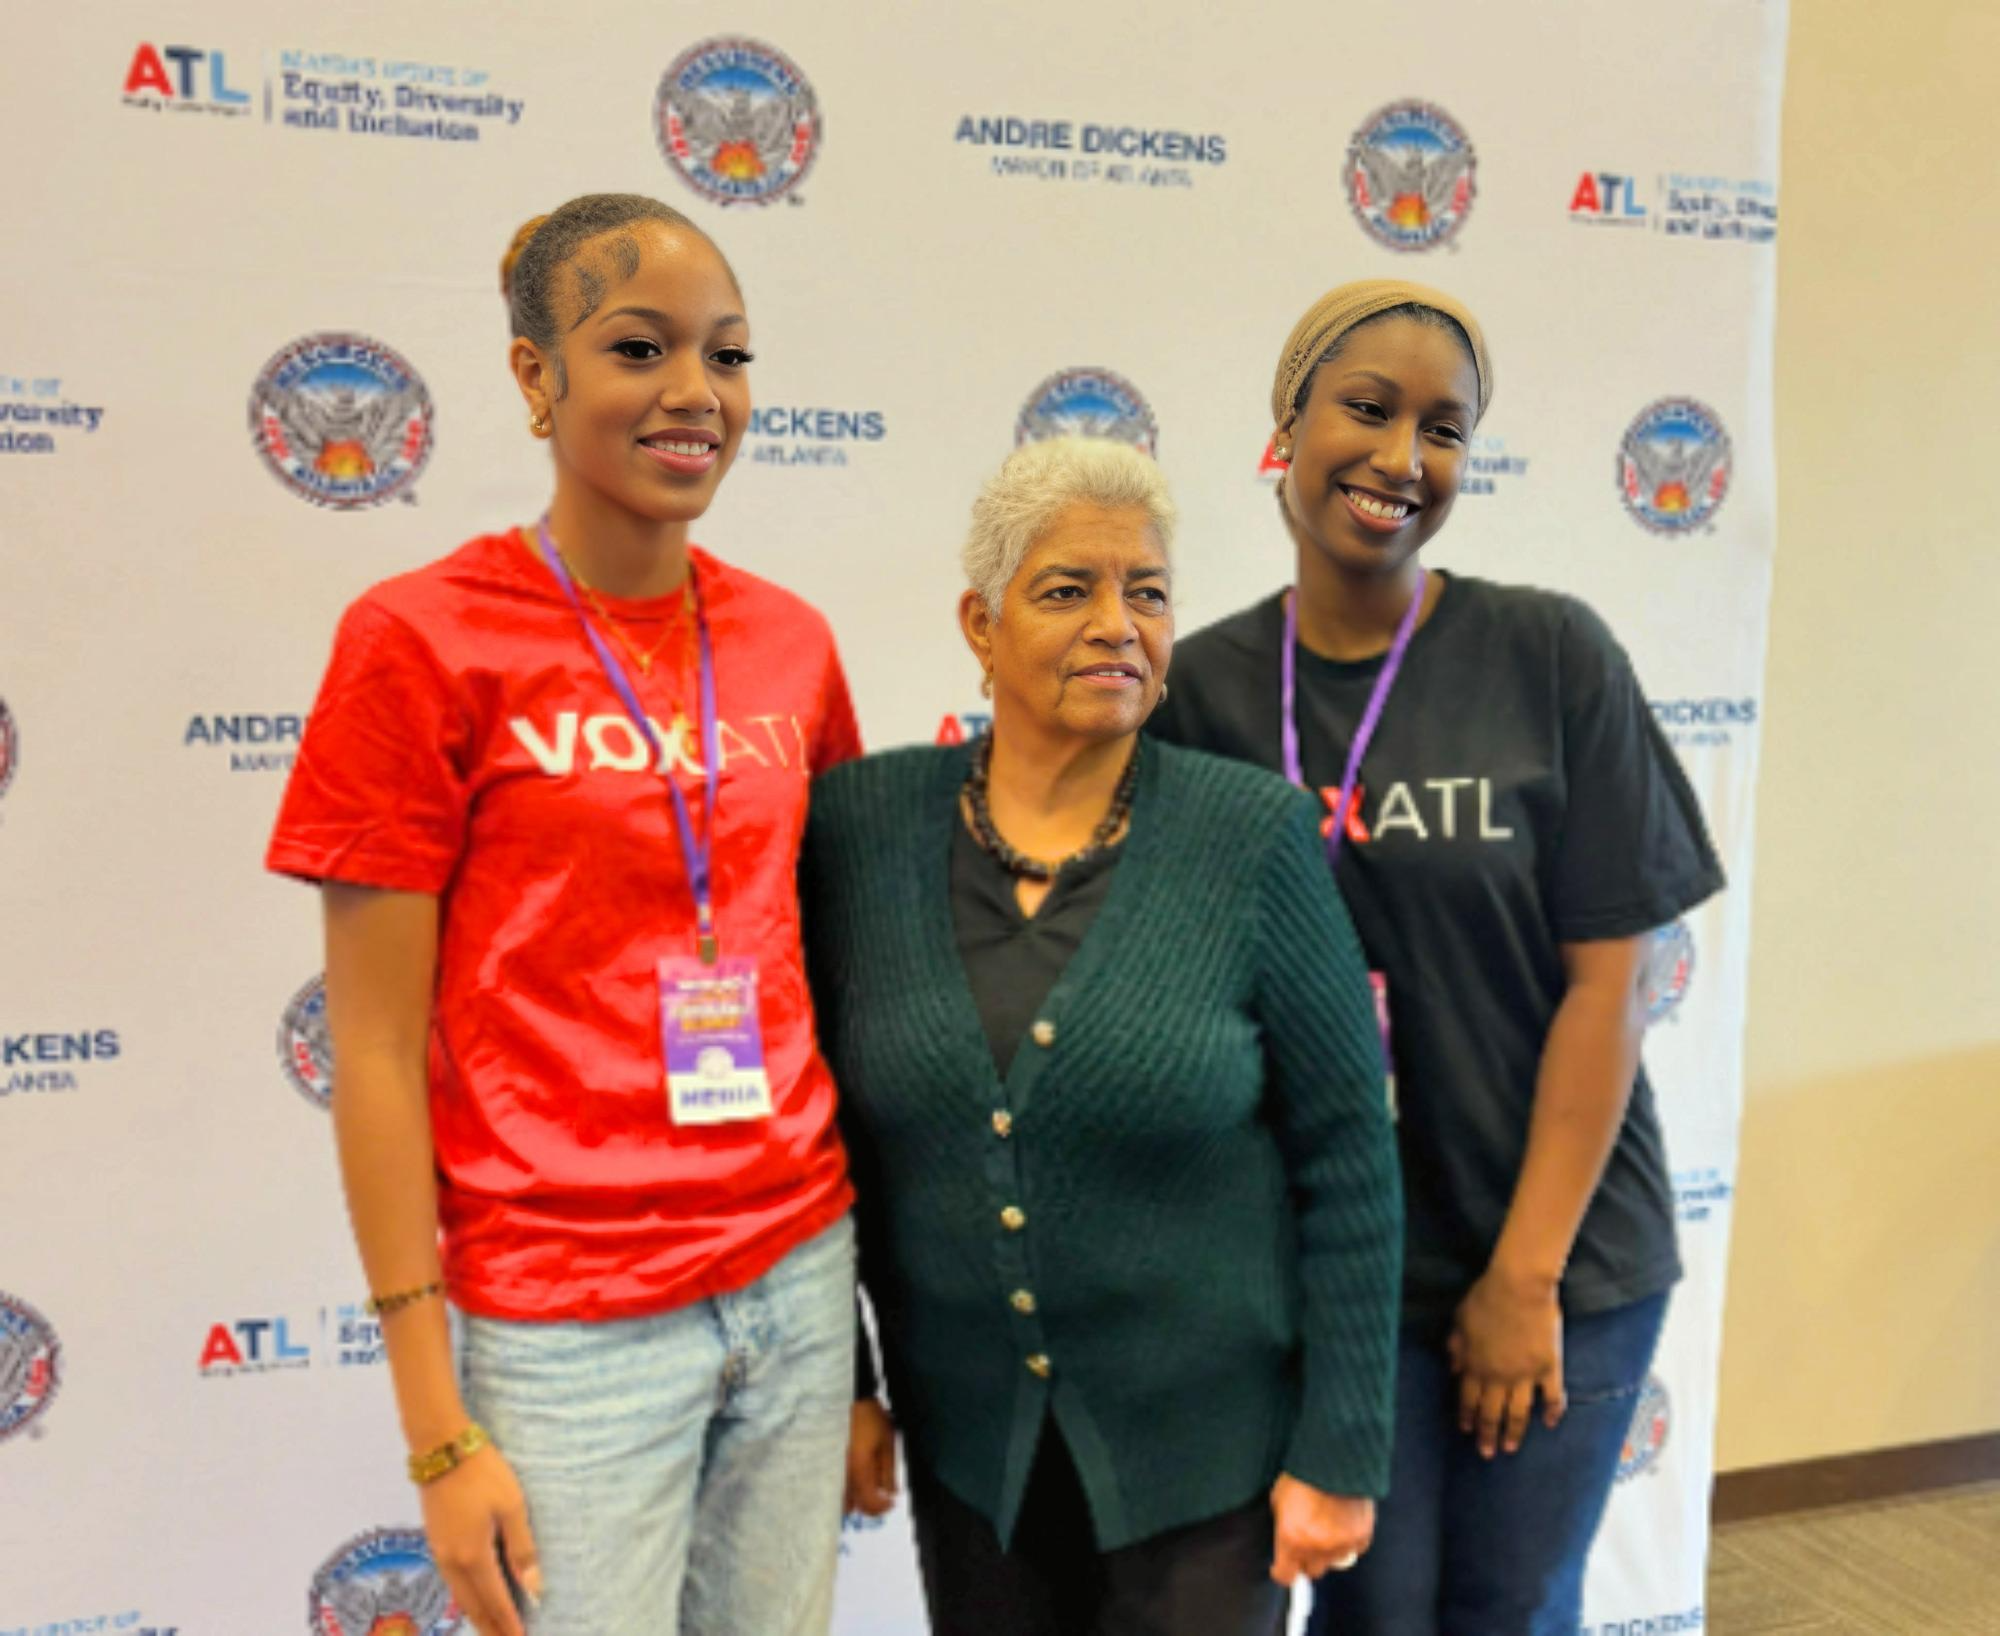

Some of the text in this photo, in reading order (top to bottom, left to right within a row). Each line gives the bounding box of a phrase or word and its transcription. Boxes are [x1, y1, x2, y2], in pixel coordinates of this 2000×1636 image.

[124, 42, 250, 103] ATL
[283, 73, 387, 110] Equity,
[395, 87, 525, 124] Diversity
[284, 106, 480, 141] and Inclusion
[955, 115, 1226, 164] ANDRE DICKENS
[1569, 172, 1647, 216] ATL
[748, 406, 887, 442] ICKENS
[184, 712, 311, 746] ANDR
[199, 1316, 310, 1367] ATL
